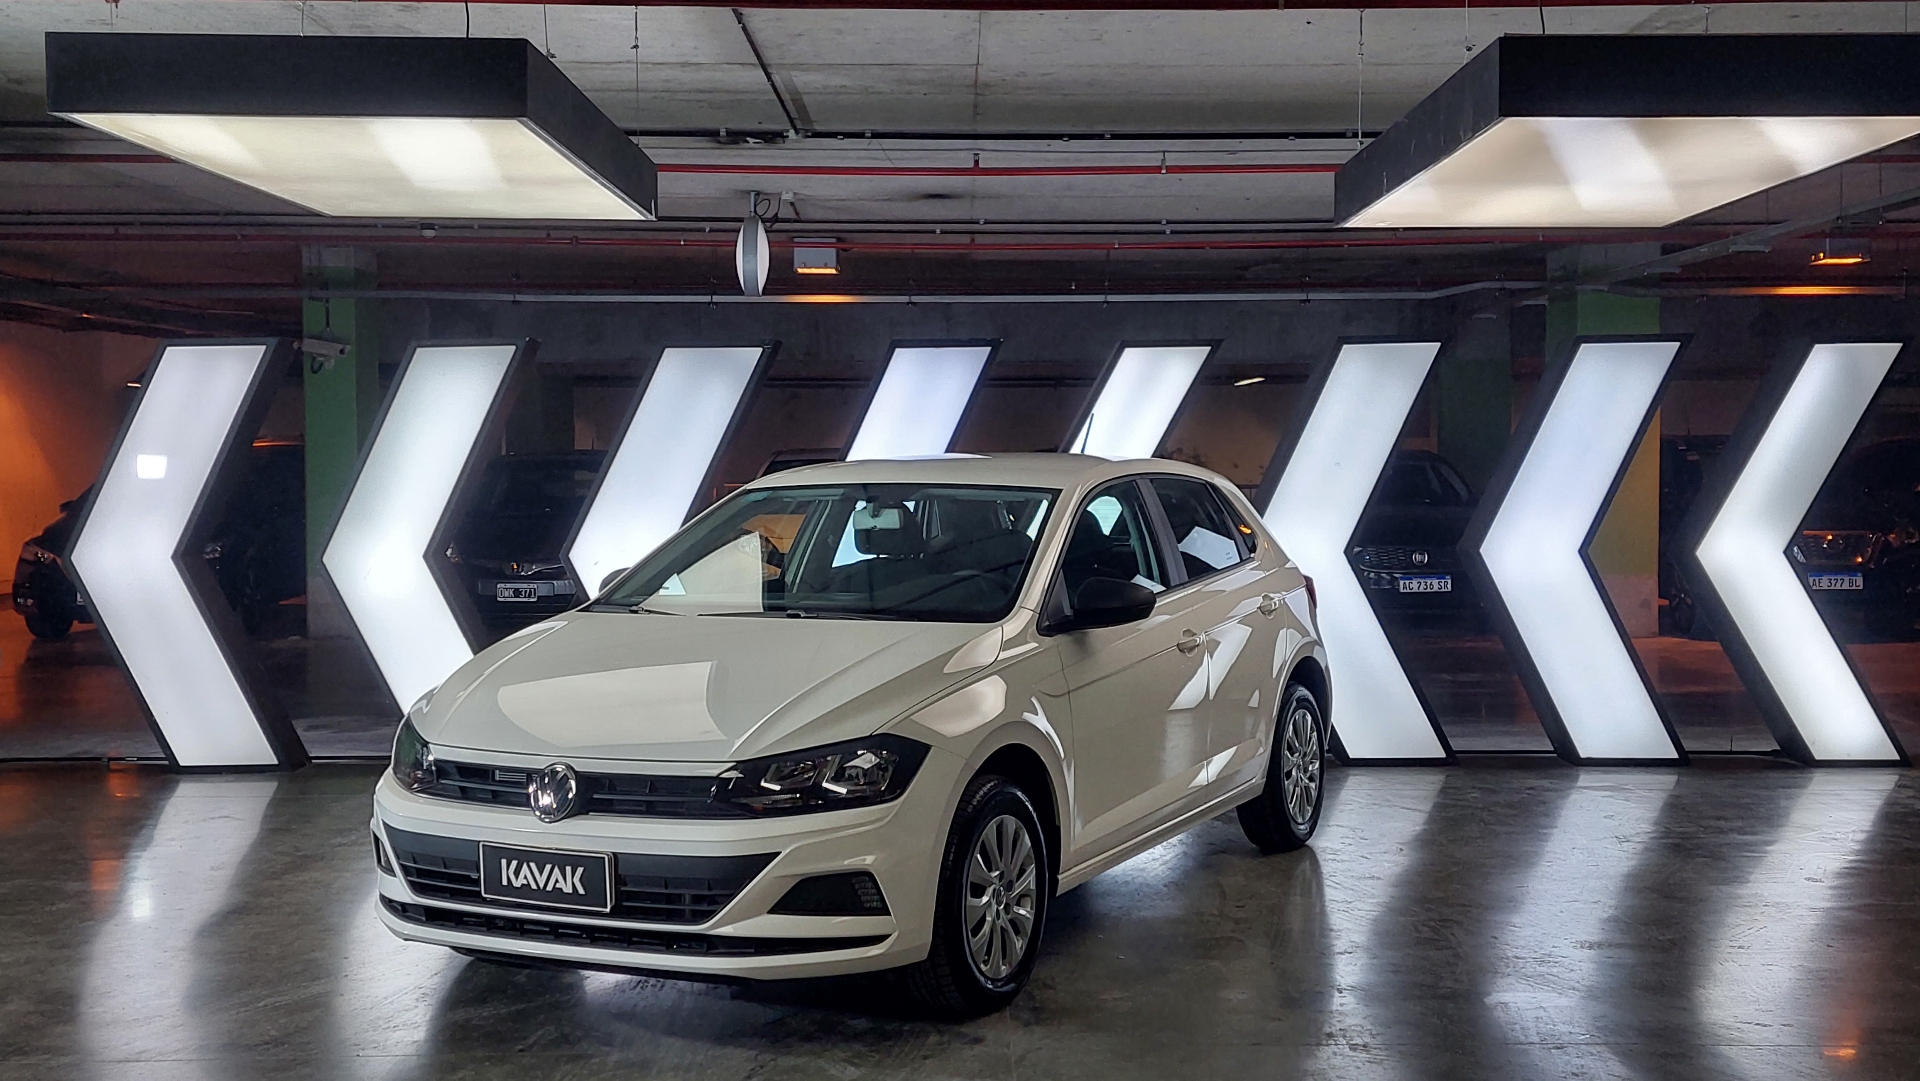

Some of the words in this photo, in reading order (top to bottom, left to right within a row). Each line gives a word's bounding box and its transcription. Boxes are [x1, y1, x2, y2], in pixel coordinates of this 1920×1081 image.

[1402, 581, 1413, 591] AC
[1417, 581, 1434, 590] 736
[1438, 581, 1449, 590] SR
[1812, 578, 1823, 588] AE
[1827, 578, 1845, 587] 377
[1848, 578, 1860, 587] BL
[519, 588, 535, 597] 371
[501, 858, 586, 895] KAVAK
